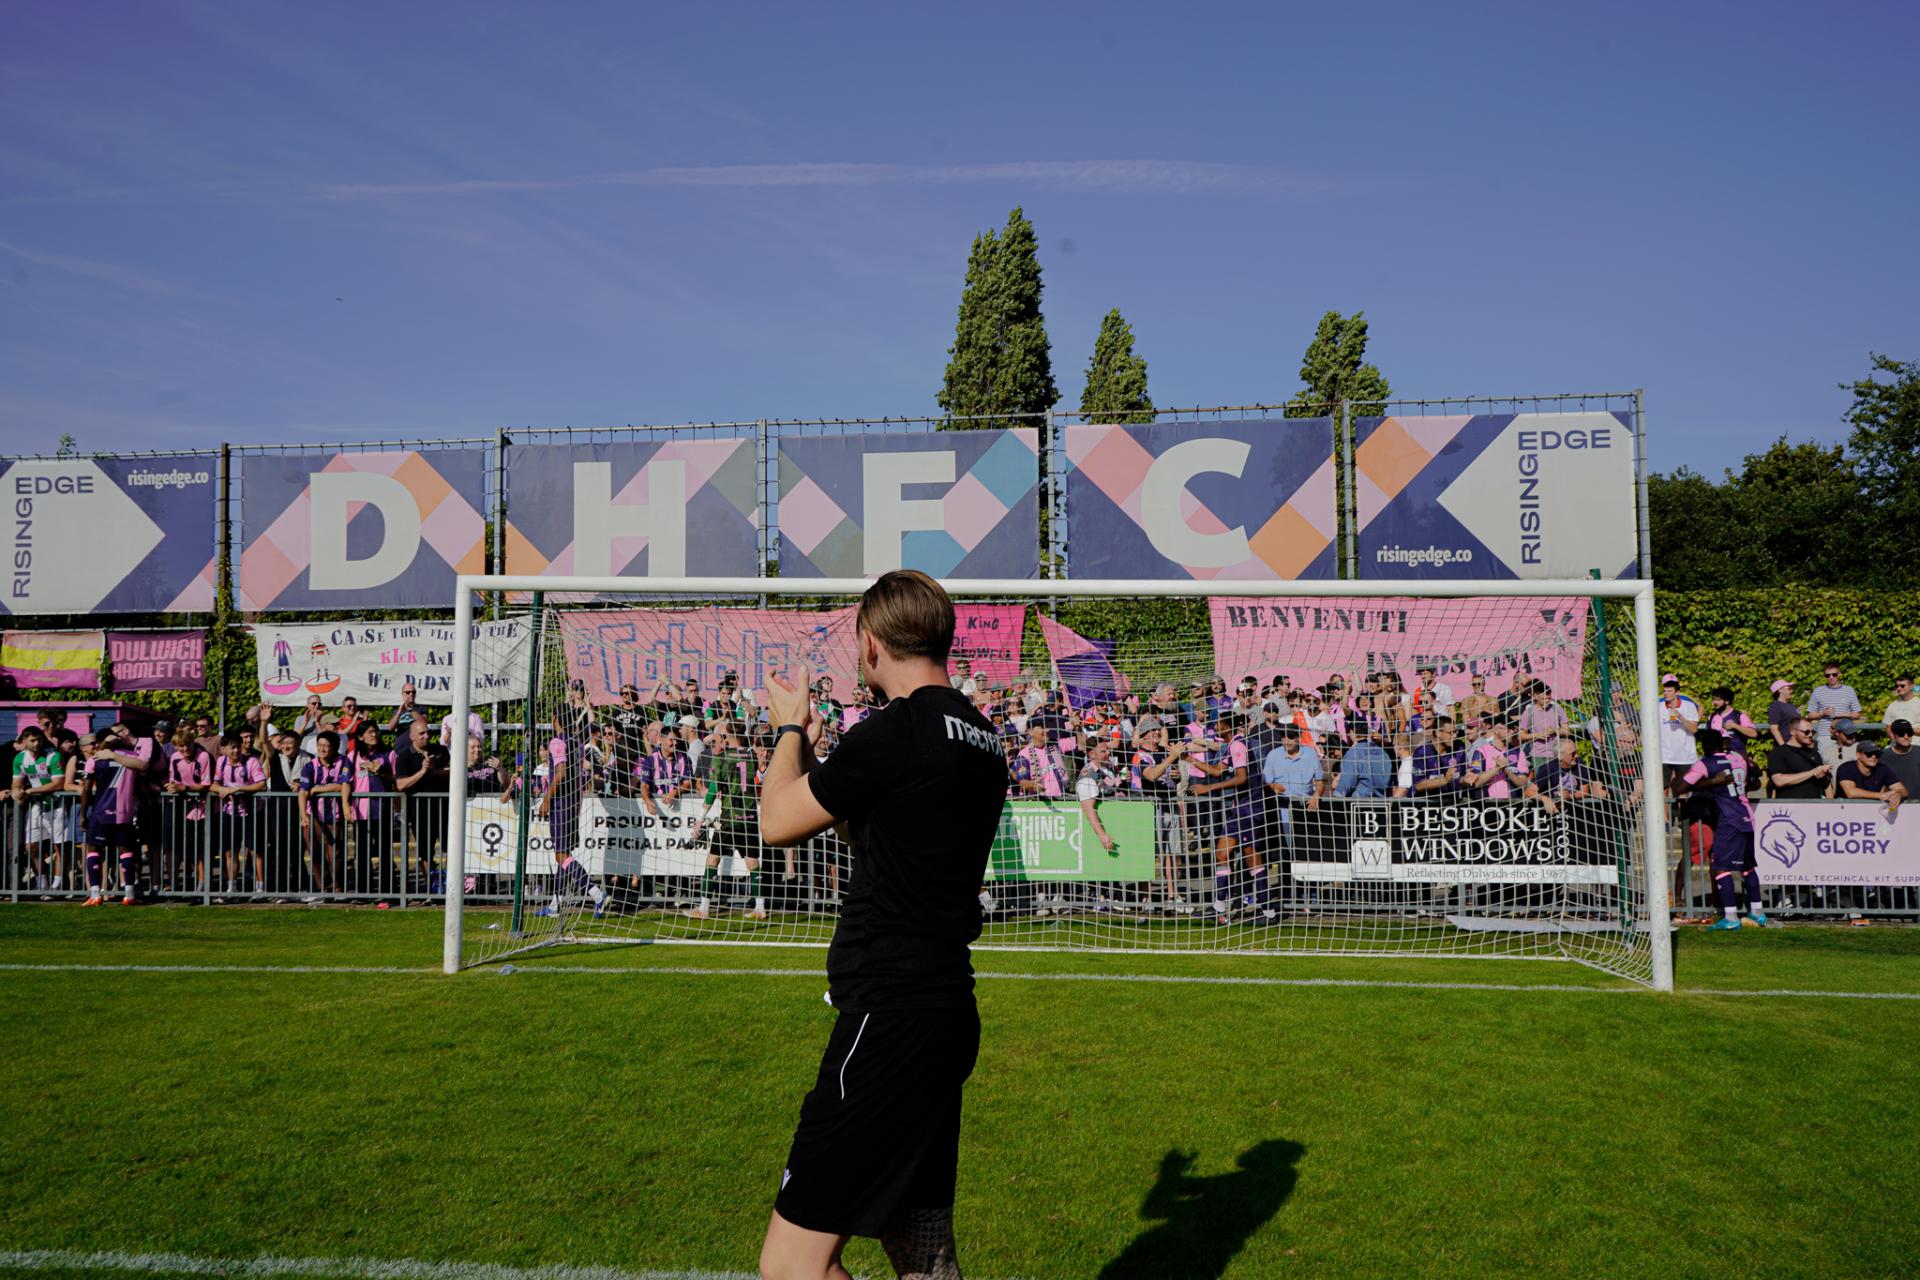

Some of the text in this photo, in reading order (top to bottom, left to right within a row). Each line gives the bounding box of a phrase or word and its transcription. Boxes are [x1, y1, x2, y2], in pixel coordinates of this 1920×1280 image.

[1518, 429, 1611, 450] EDGE
[15, 476, 94, 495] EDGE
[128, 468, 209, 490] risingedge.co
[308, 439, 1253, 591] D H F C
[1518, 453, 1541, 565] RISING
[13, 498, 33, 598] RISING
[1376, 545, 1473, 567] risingedge.co
[1226, 606, 1408, 633] BENVENUTI
[111, 638, 202, 662] DULWICH
[112, 661, 201, 681] HAMLET FC
[1366, 651, 1400, 673] IN
[594, 816, 655, 829] PROUD
[662, 816, 682, 829] TO
[1401, 806, 1551, 832] BESPOKE
[1816, 822, 1876, 837] HOPE
[584, 837, 662, 851] OFFICIAL
[1401, 837, 1553, 862] WINDOWS
[1817, 839, 1891, 855] GLORY
[1407, 868, 1460, 879] Reflecting
[1463, 868, 1508, 878] Dulwich
[1510, 869, 1539, 878] since
[1875, 875, 1890, 883] KIT
